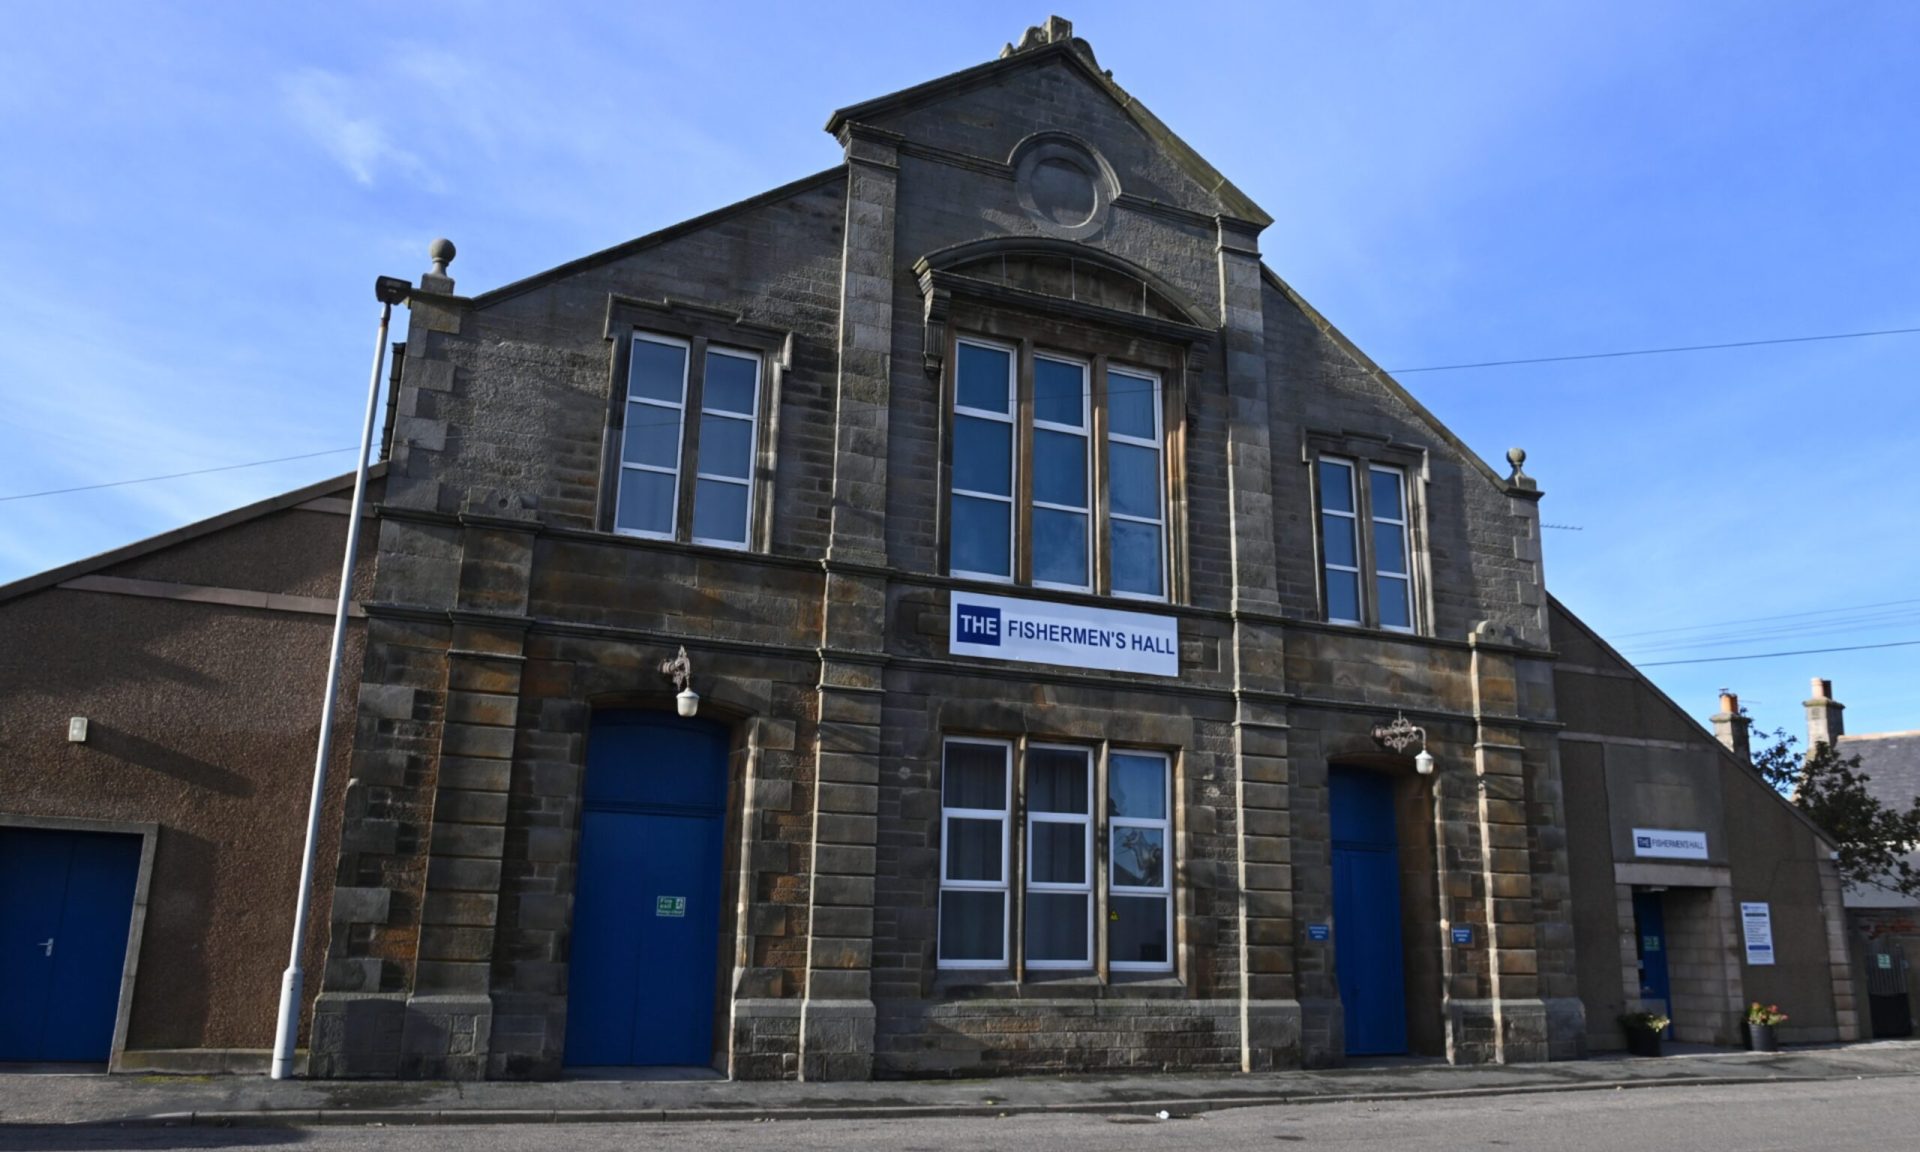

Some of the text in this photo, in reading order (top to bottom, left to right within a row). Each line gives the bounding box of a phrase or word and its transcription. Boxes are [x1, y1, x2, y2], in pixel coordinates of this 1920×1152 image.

[960, 614, 1175, 655] THE FISHERMEN'S HALL
